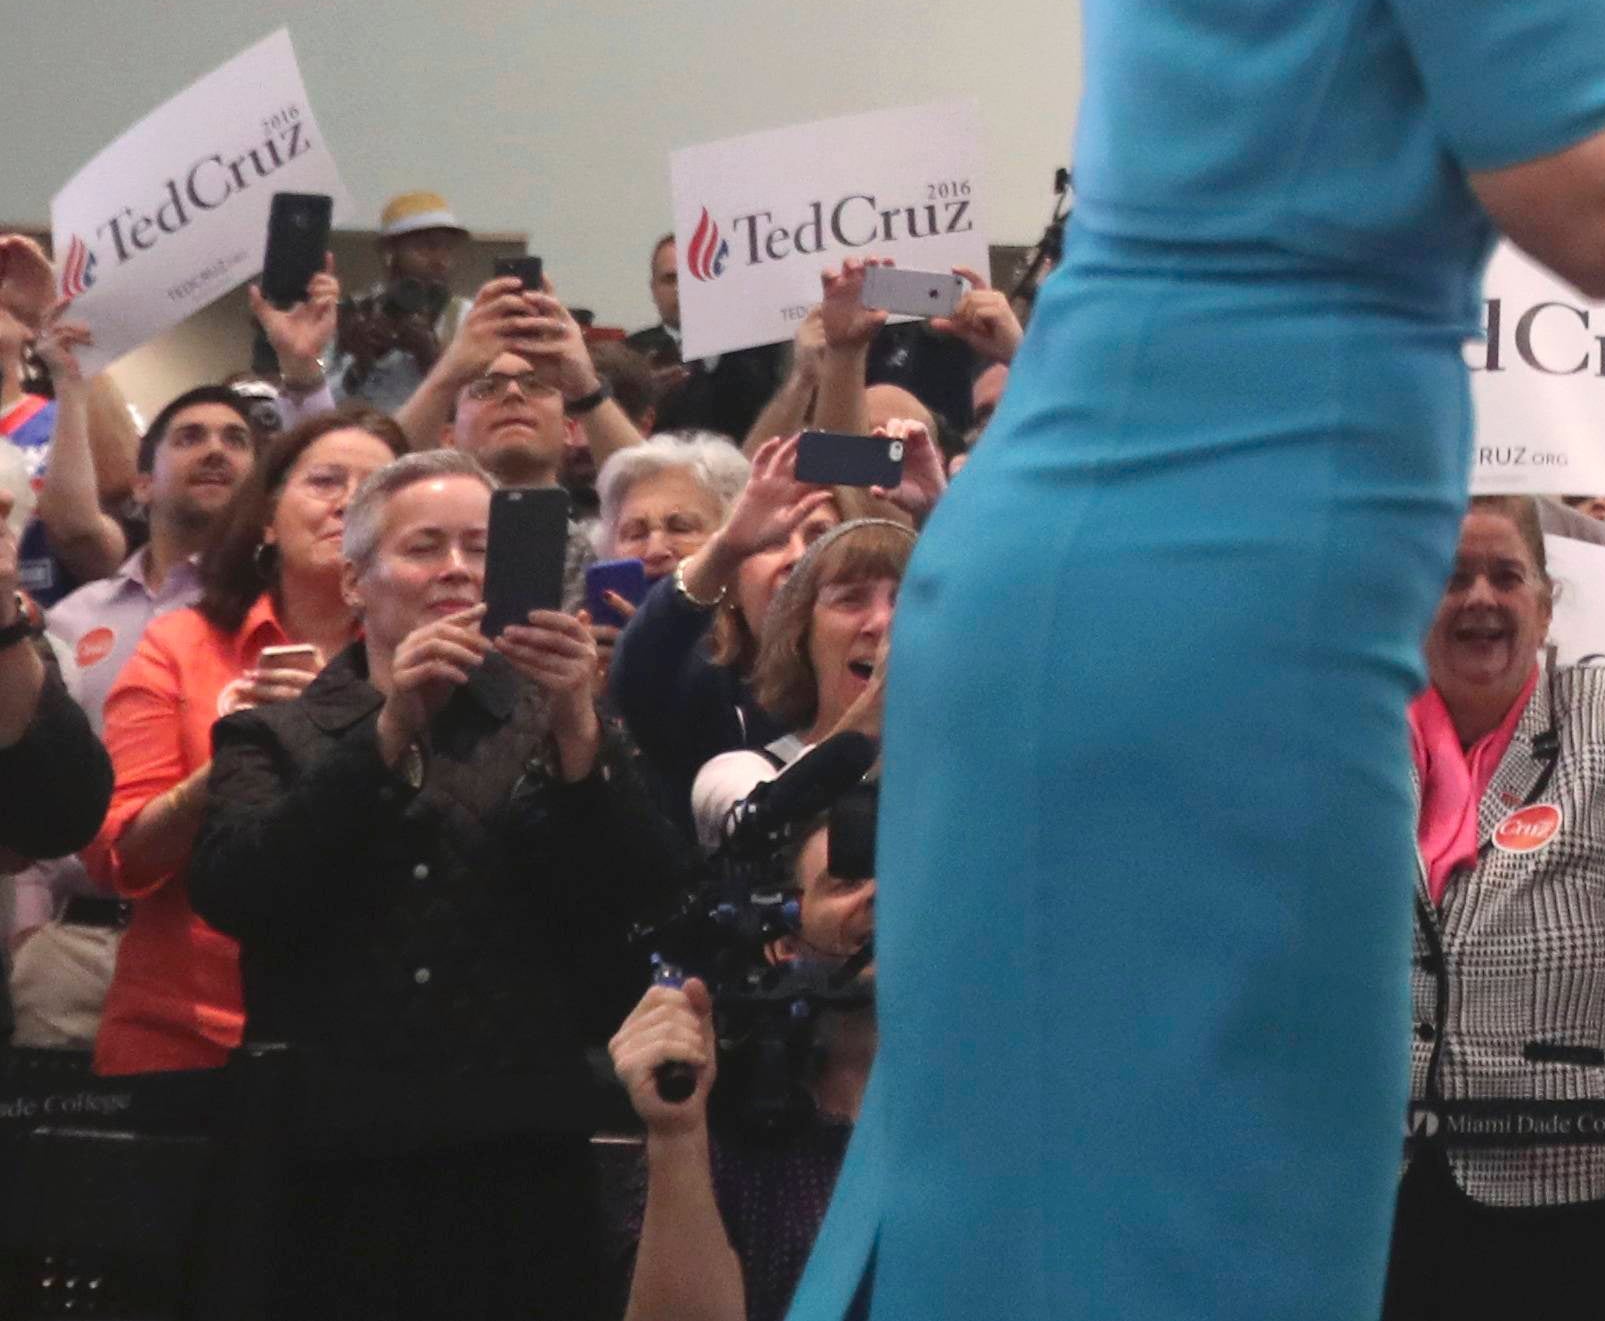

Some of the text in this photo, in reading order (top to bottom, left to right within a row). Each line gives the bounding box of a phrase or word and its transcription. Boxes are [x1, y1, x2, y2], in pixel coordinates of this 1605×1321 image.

[262, 104, 300, 136] 2016
[927, 180, 971, 200] 2016
[1448, 1114, 1511, 1133] Miami
[1518, 1114, 1571, 1134] Dade
